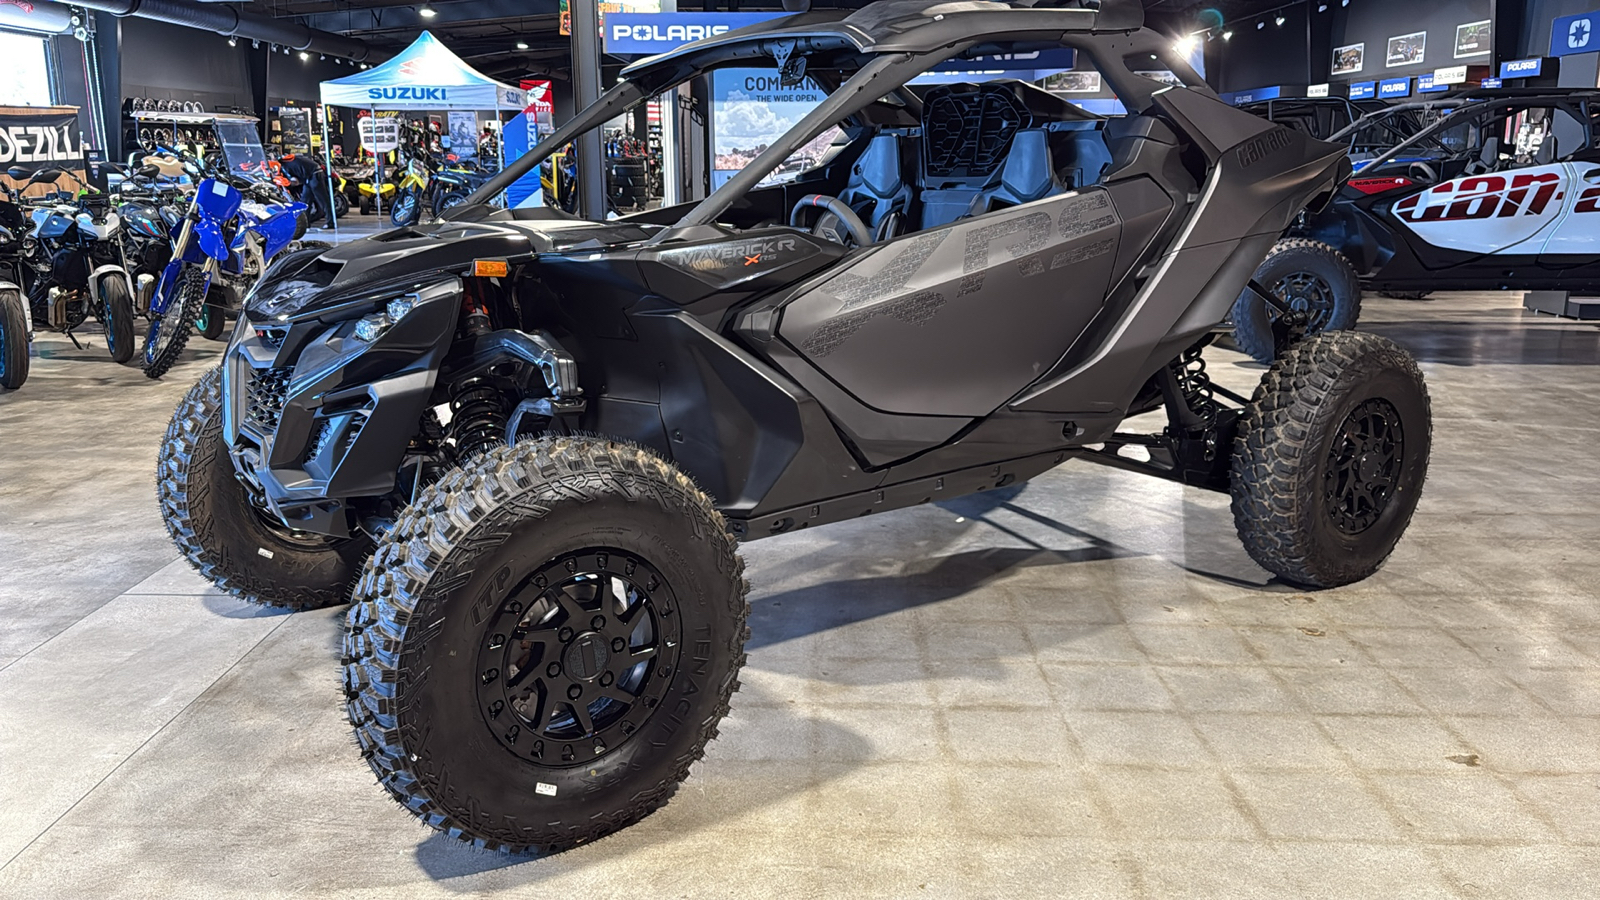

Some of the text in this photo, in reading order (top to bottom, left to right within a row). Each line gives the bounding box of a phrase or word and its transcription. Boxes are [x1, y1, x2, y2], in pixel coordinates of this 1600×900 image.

[612, 25, 730, 41] POLARIS
[1507, 60, 1538, 72] POLARIS
[744, 76, 824, 92] COMAN
[1381, 82, 1407, 93] POLARIS
[368, 87, 447, 101] SUZUKI
[756, 94, 817, 103] THE WIDE OPEN
[0, 125, 84, 163] DEZILL
[678, 239, 796, 266] MAVERICK R
